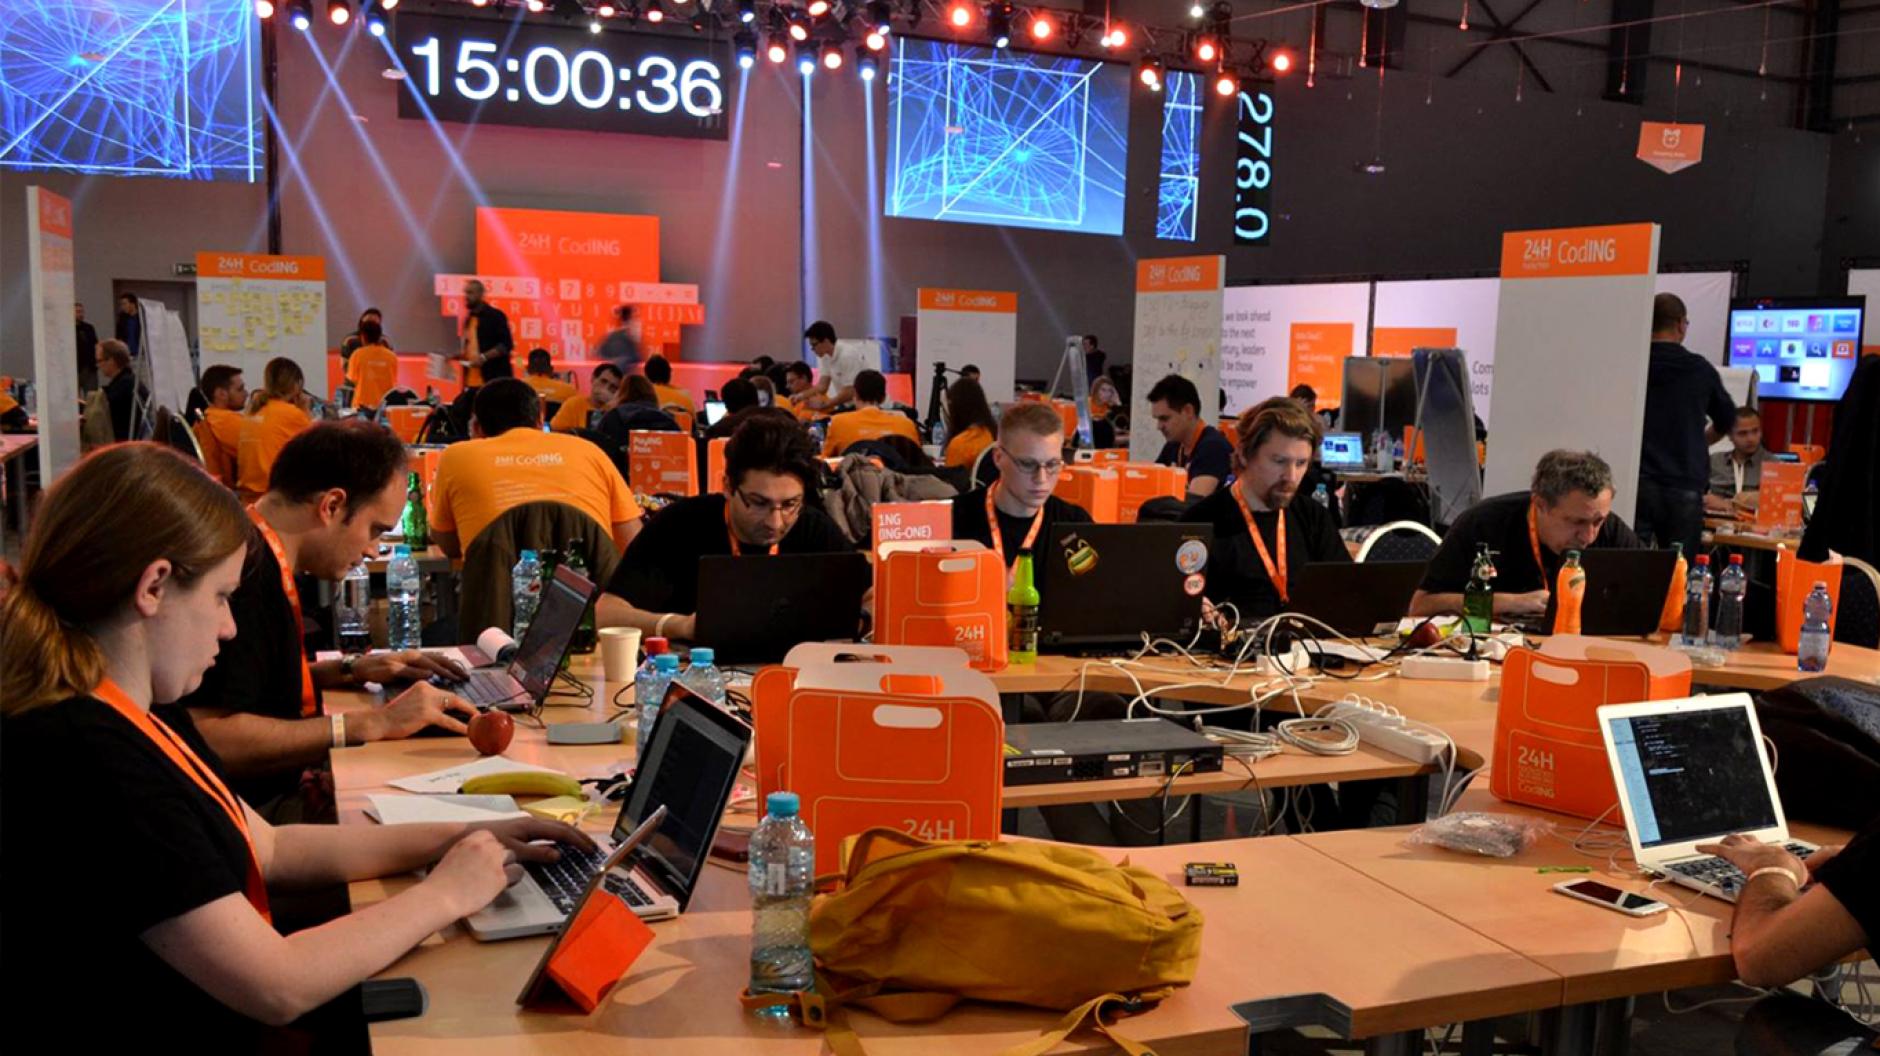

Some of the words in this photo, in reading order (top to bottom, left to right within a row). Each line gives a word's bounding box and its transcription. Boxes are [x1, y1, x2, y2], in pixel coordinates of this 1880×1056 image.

[412, 37, 722, 117] 15:00:36
[1235, 91, 1273, 240] 278.0
[518, 232, 550, 249] 24H
[558, 236, 621, 257] CodING
[1524, 238, 1551, 260] 24H
[1558, 238, 1616, 265] CodING
[218, 256, 244, 269] 24H
[249, 260, 299, 274] CodING
[1236, 311, 1249, 321] look
[1250, 310, 1271, 321] ahead
[1229, 329, 1239, 338] the
[1241, 329, 1255, 338] next
[1241, 345, 1266, 356] leaders
[1227, 360, 1235, 371] be
[1235, 360, 1253, 372] those
[1228, 378, 1257, 388] empower
[516, 452, 563, 466] CodING
[878, 513, 901, 526] 1NG
[878, 525, 932, 540] (ING-ONE)
[955, 624, 985, 641] 24H
[1518, 746, 1554, 771] 24H
[903, 818, 955, 841] 24H
